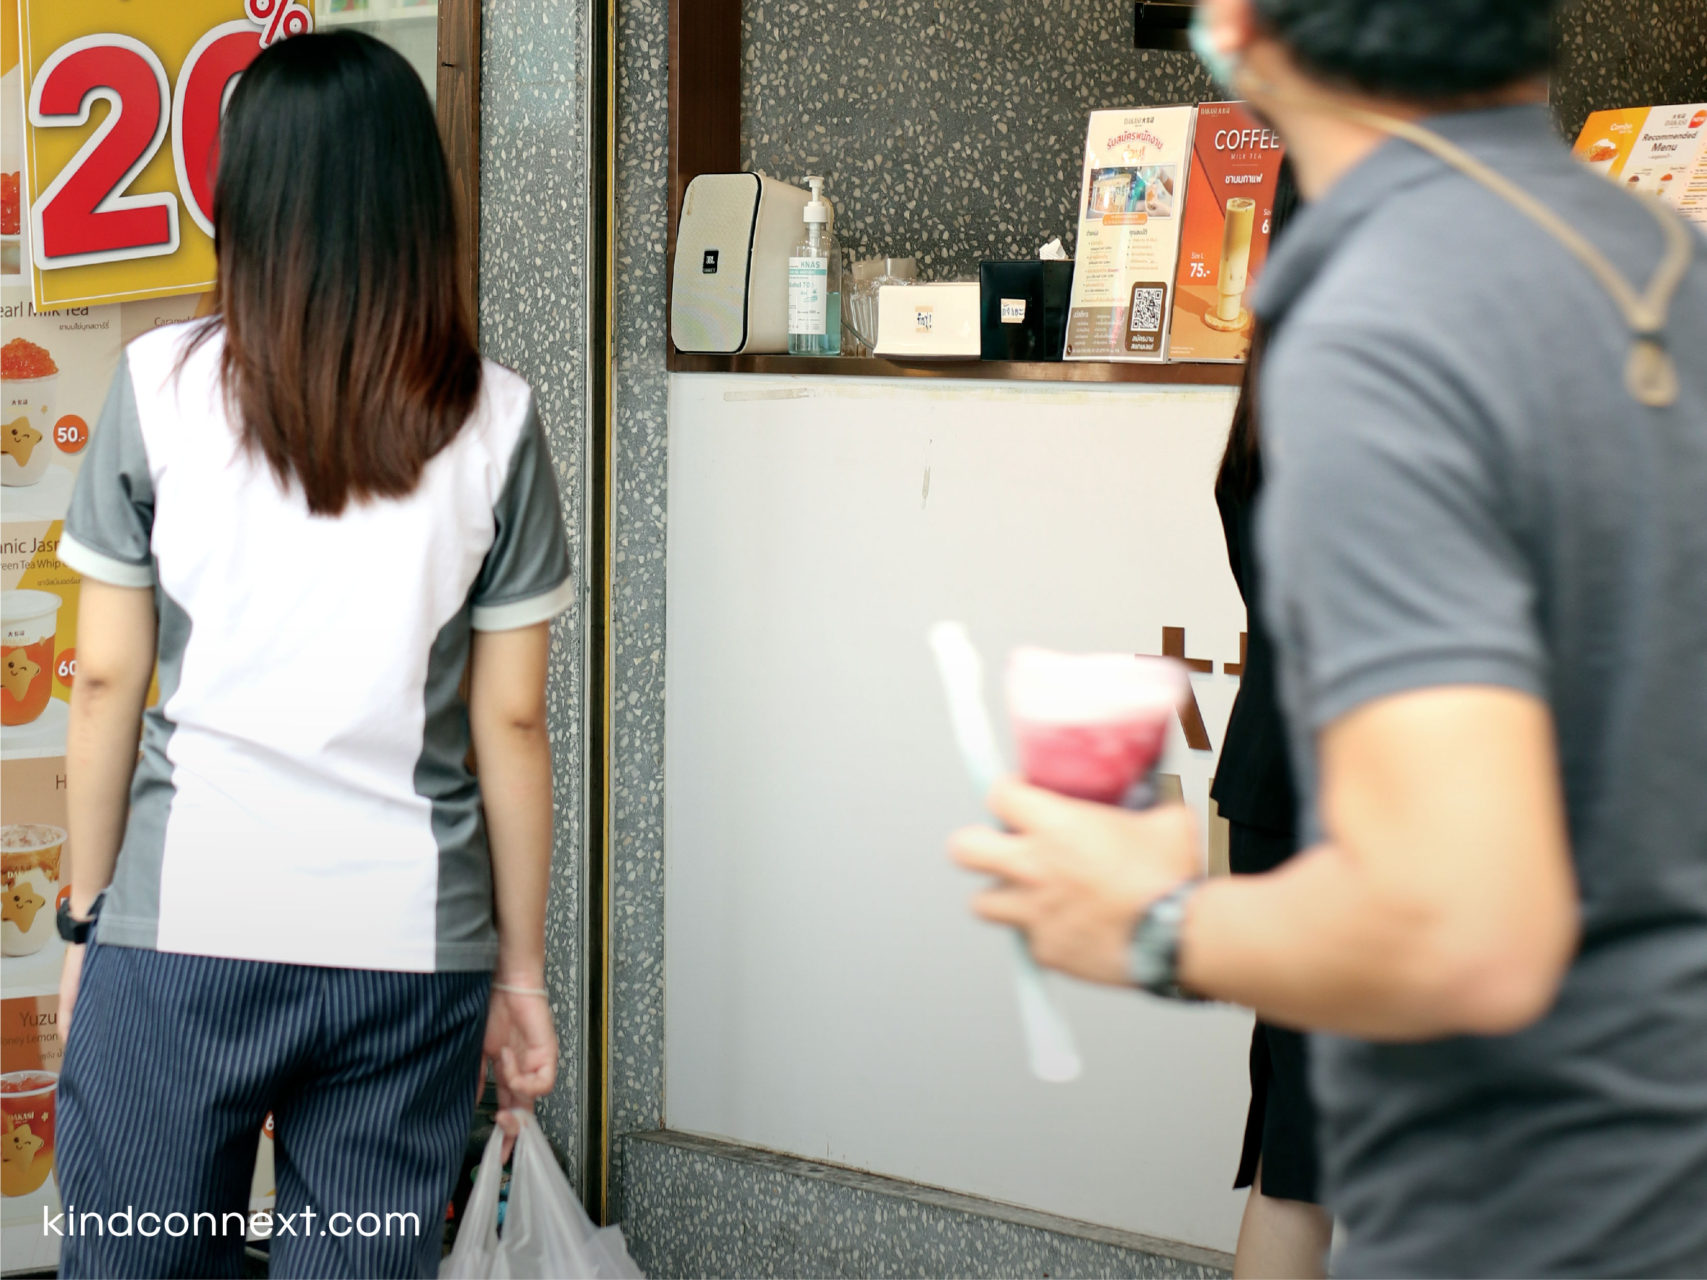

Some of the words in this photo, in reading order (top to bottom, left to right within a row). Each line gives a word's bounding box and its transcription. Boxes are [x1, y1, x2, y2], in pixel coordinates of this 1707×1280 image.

[1215, 128, 1280, 150] COFFEE
[1642, 131, 1698, 141] Recommended
[1651, 143, 1678, 152] Menu
[1190, 262, 1211, 278] 75.-
[57, 426, 85, 443] 50.-
[1, 538, 26, 554] nic
[20, 560, 35, 569] Tea
[37, 558, 60, 570] Whip
[19, 1011, 57, 1027] Yuzu
